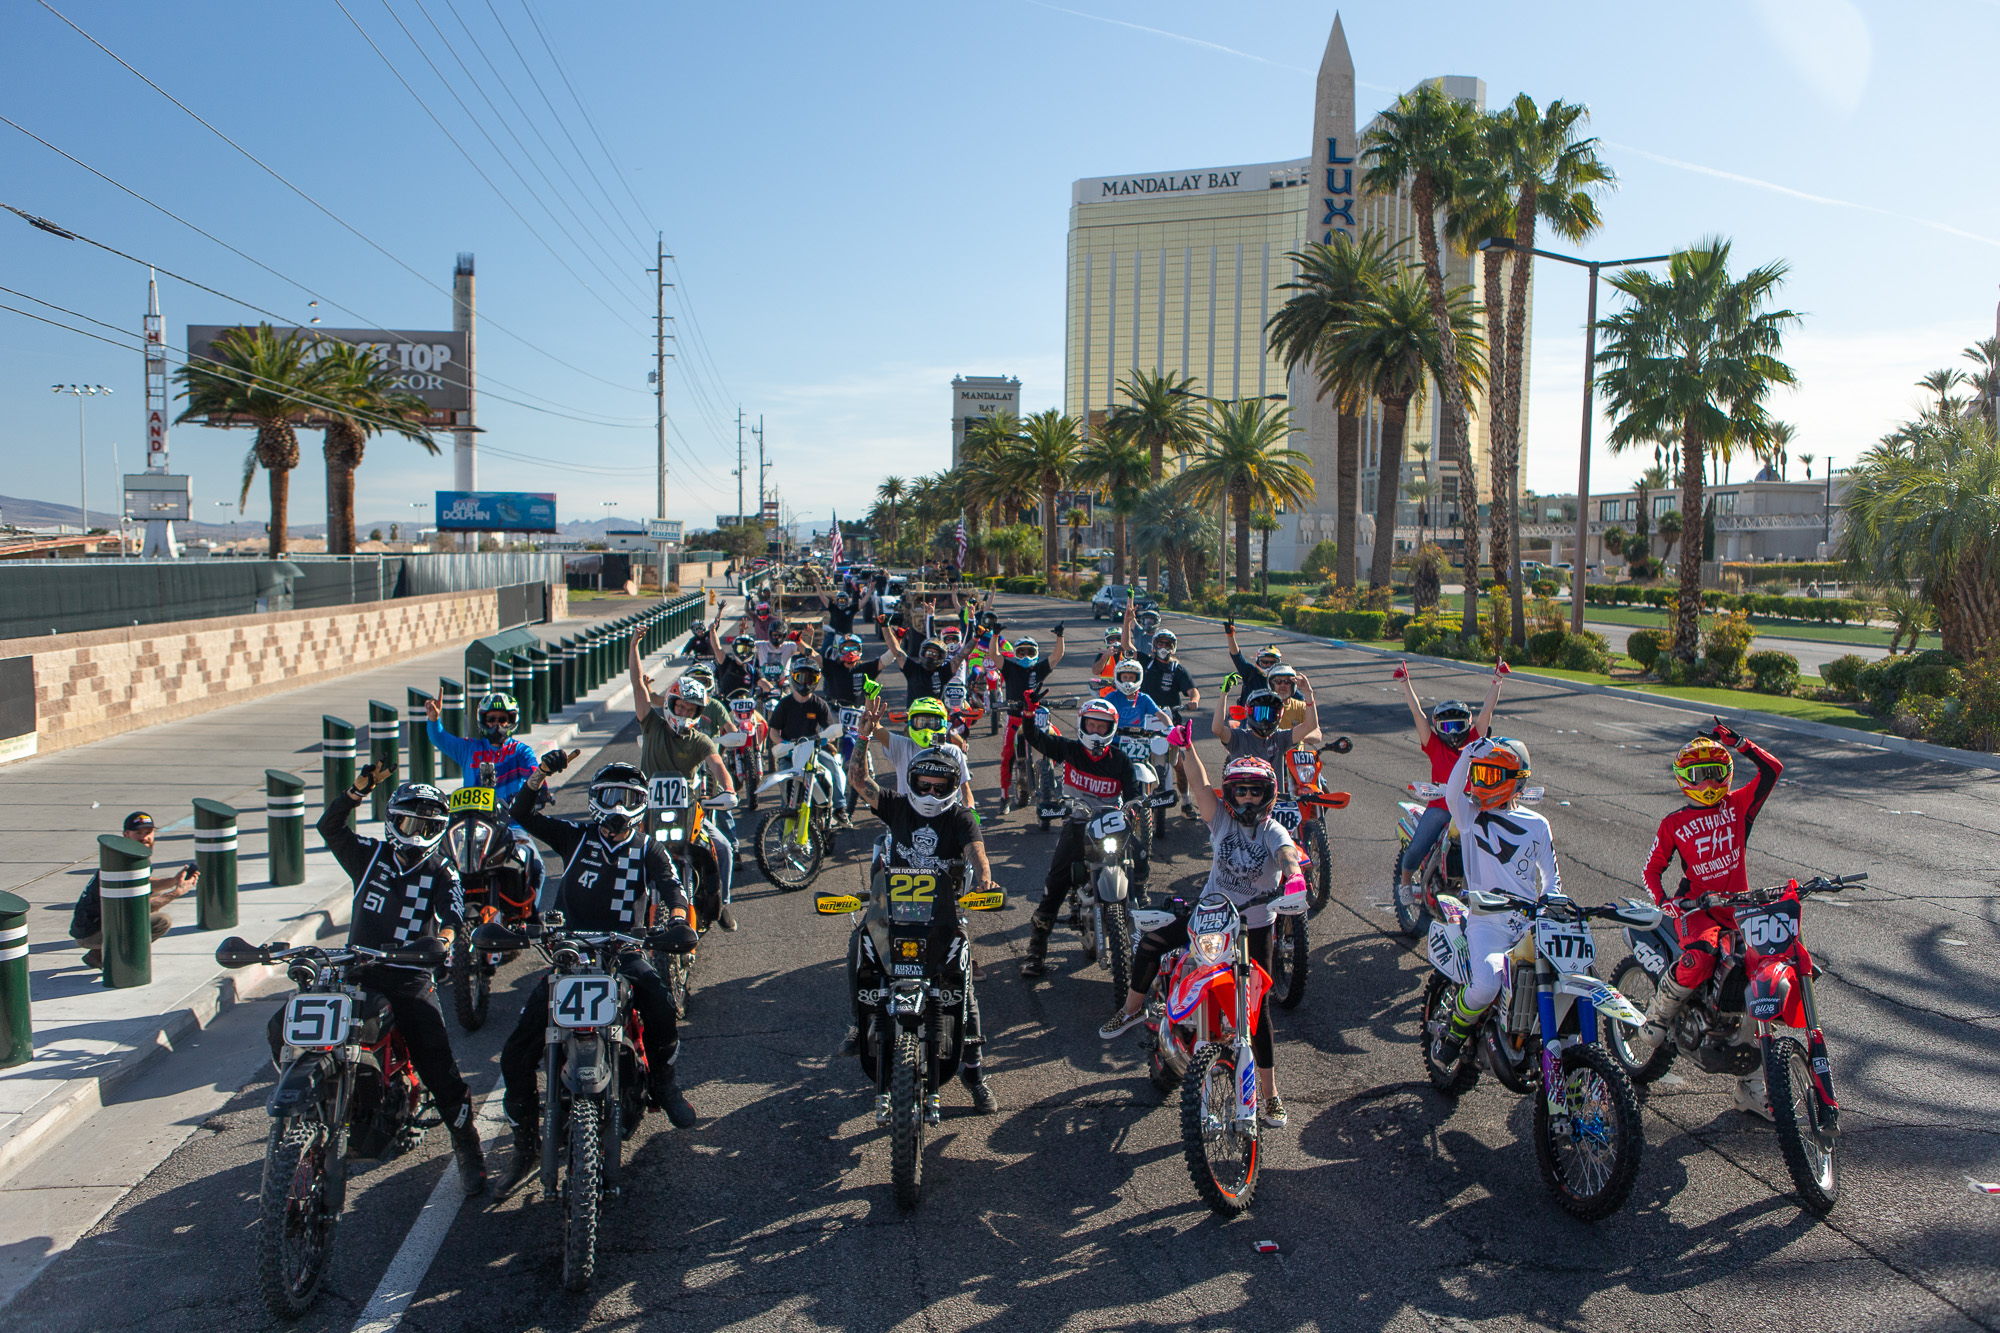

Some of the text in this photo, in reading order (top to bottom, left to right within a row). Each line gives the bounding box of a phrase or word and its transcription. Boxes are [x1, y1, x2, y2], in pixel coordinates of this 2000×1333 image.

[1101, 171, 1241, 197] MANDALAY BAY
[397, 343, 451, 371] TOP
[961, 391, 1013, 400] MANDALAY
[979, 404, 996, 412] BAY
[442, 510, 490, 521] DOLPHIN
[453, 502, 480, 512] BABY
[652, 523, 681, 532] MOTEL
[1070, 768, 1117, 795] BILTWELL
[452, 789, 490, 807] N98S
[1091, 811, 1126, 839] 13
[1675, 807, 1736, 843] FASTHOUSE
[578, 871, 599, 889] 47
[890, 874, 936, 902] 22
[363, 891, 386, 913] 51
[820, 901, 853, 910] BILTWELL
[968, 896, 1002, 908] BILTWELL
[1544, 934, 1594, 959] T177A
[559, 981, 609, 1022] 47
[291, 999, 343, 1041] 51
